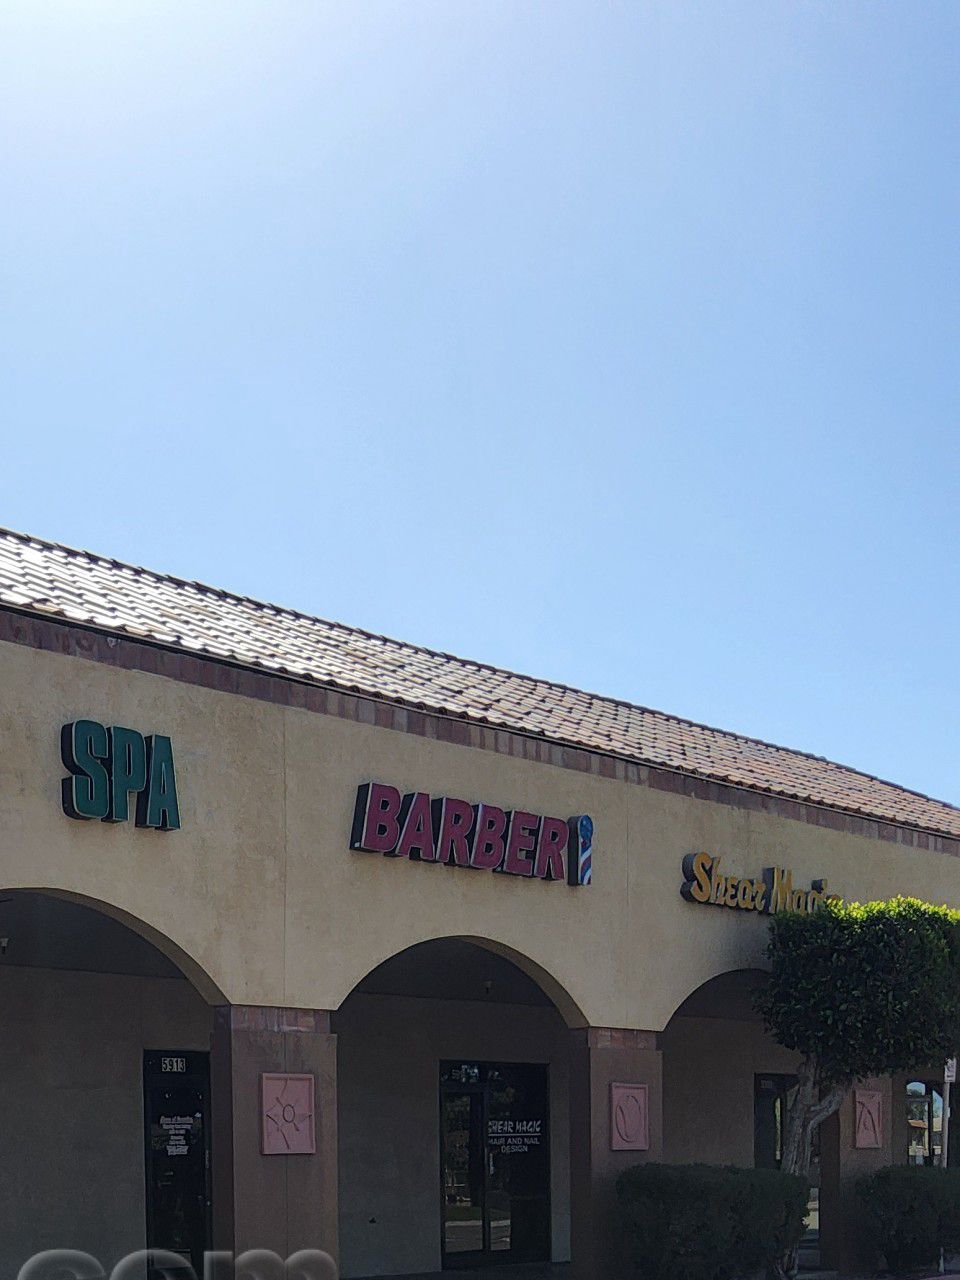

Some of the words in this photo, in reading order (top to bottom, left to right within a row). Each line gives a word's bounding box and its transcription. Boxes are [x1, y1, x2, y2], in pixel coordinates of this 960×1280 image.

[62, 719, 181, 831] SPA
[352, 782, 571, 881] BARBER
[685, 851, 767, 912] Shear
[162, 1057, 186, 1073] 5913
[515, 1120, 541, 1133] MAGIC
[507, 1137, 523, 1145] AND
[524, 1137, 541, 1145] NAIL
[501, 1145, 528, 1154] DESIGN
